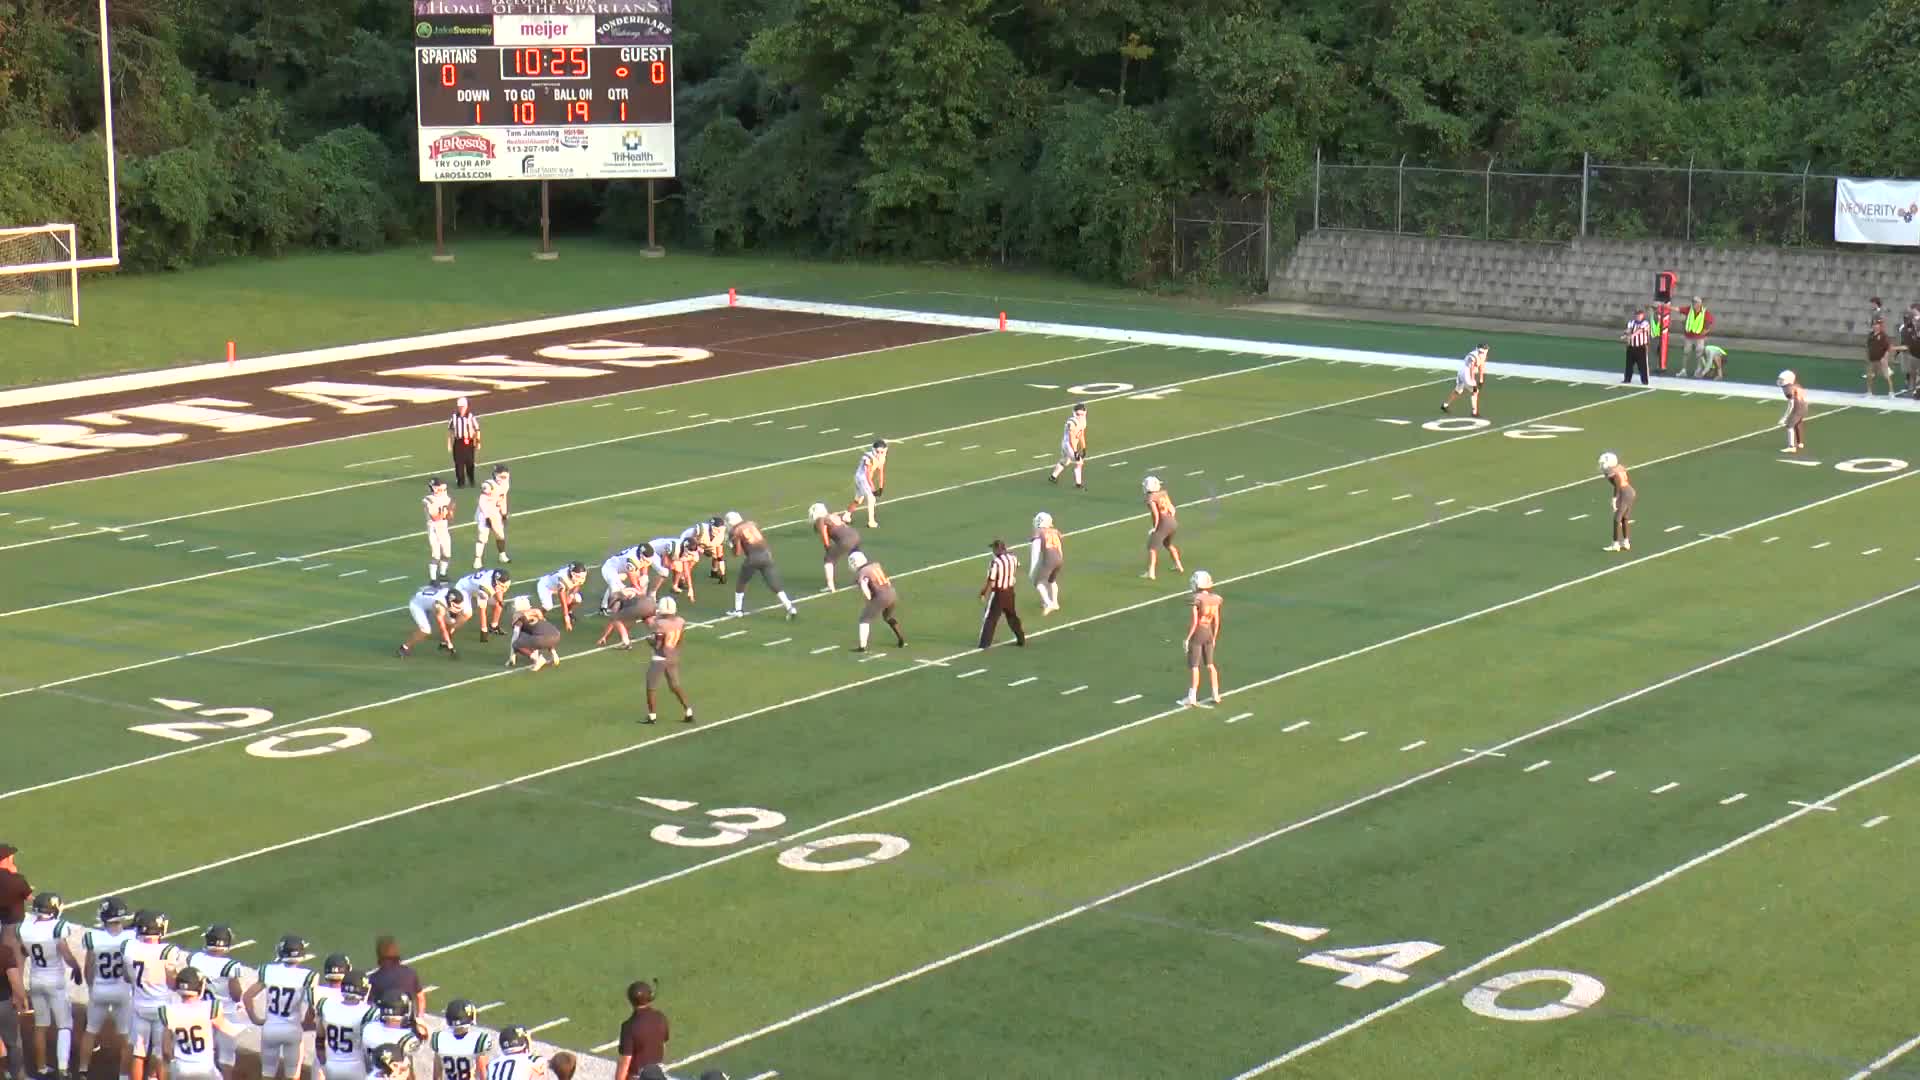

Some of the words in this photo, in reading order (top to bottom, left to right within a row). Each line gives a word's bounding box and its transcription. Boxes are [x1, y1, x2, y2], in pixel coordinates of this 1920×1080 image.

[528, 5, 556, 14] THE
[565, 2, 658, 14] SPARTANS
[520, 20, 569, 39] meijer
[421, 49, 477, 64] SPARTANS
[514, 47, 587, 75] 10:25
[620, 47, 666, 62] GUEST
[441, 63, 456, 87] 0
[651, 61, 665, 84] 0
[457, 89, 490, 102] DOWN
[504, 89, 518, 102] TO
[520, 89, 536, 102] GO
[554, 88, 577, 101] BALL
[579, 88, 593, 100] ON
[607, 88, 629, 101] QTR
[476, 103, 481, 124] 1
[513, 102, 536, 125] 10
[567, 101, 589, 122] 19
[620, 101, 626, 121] 1
[435, 160, 450, 168] TRY
[453, 160, 472, 168] OUR
[474, 160, 491, 168] APP
[31, 943, 47, 967] 8
[98, 951, 124, 980] 22
[132, 960, 145, 989] 7
[268, 985, 296, 1018] 37
[175, 1025, 205, 1056] 26
[326, 1024, 353, 1054] 85
[490, 1059, 517, 1080] 10
